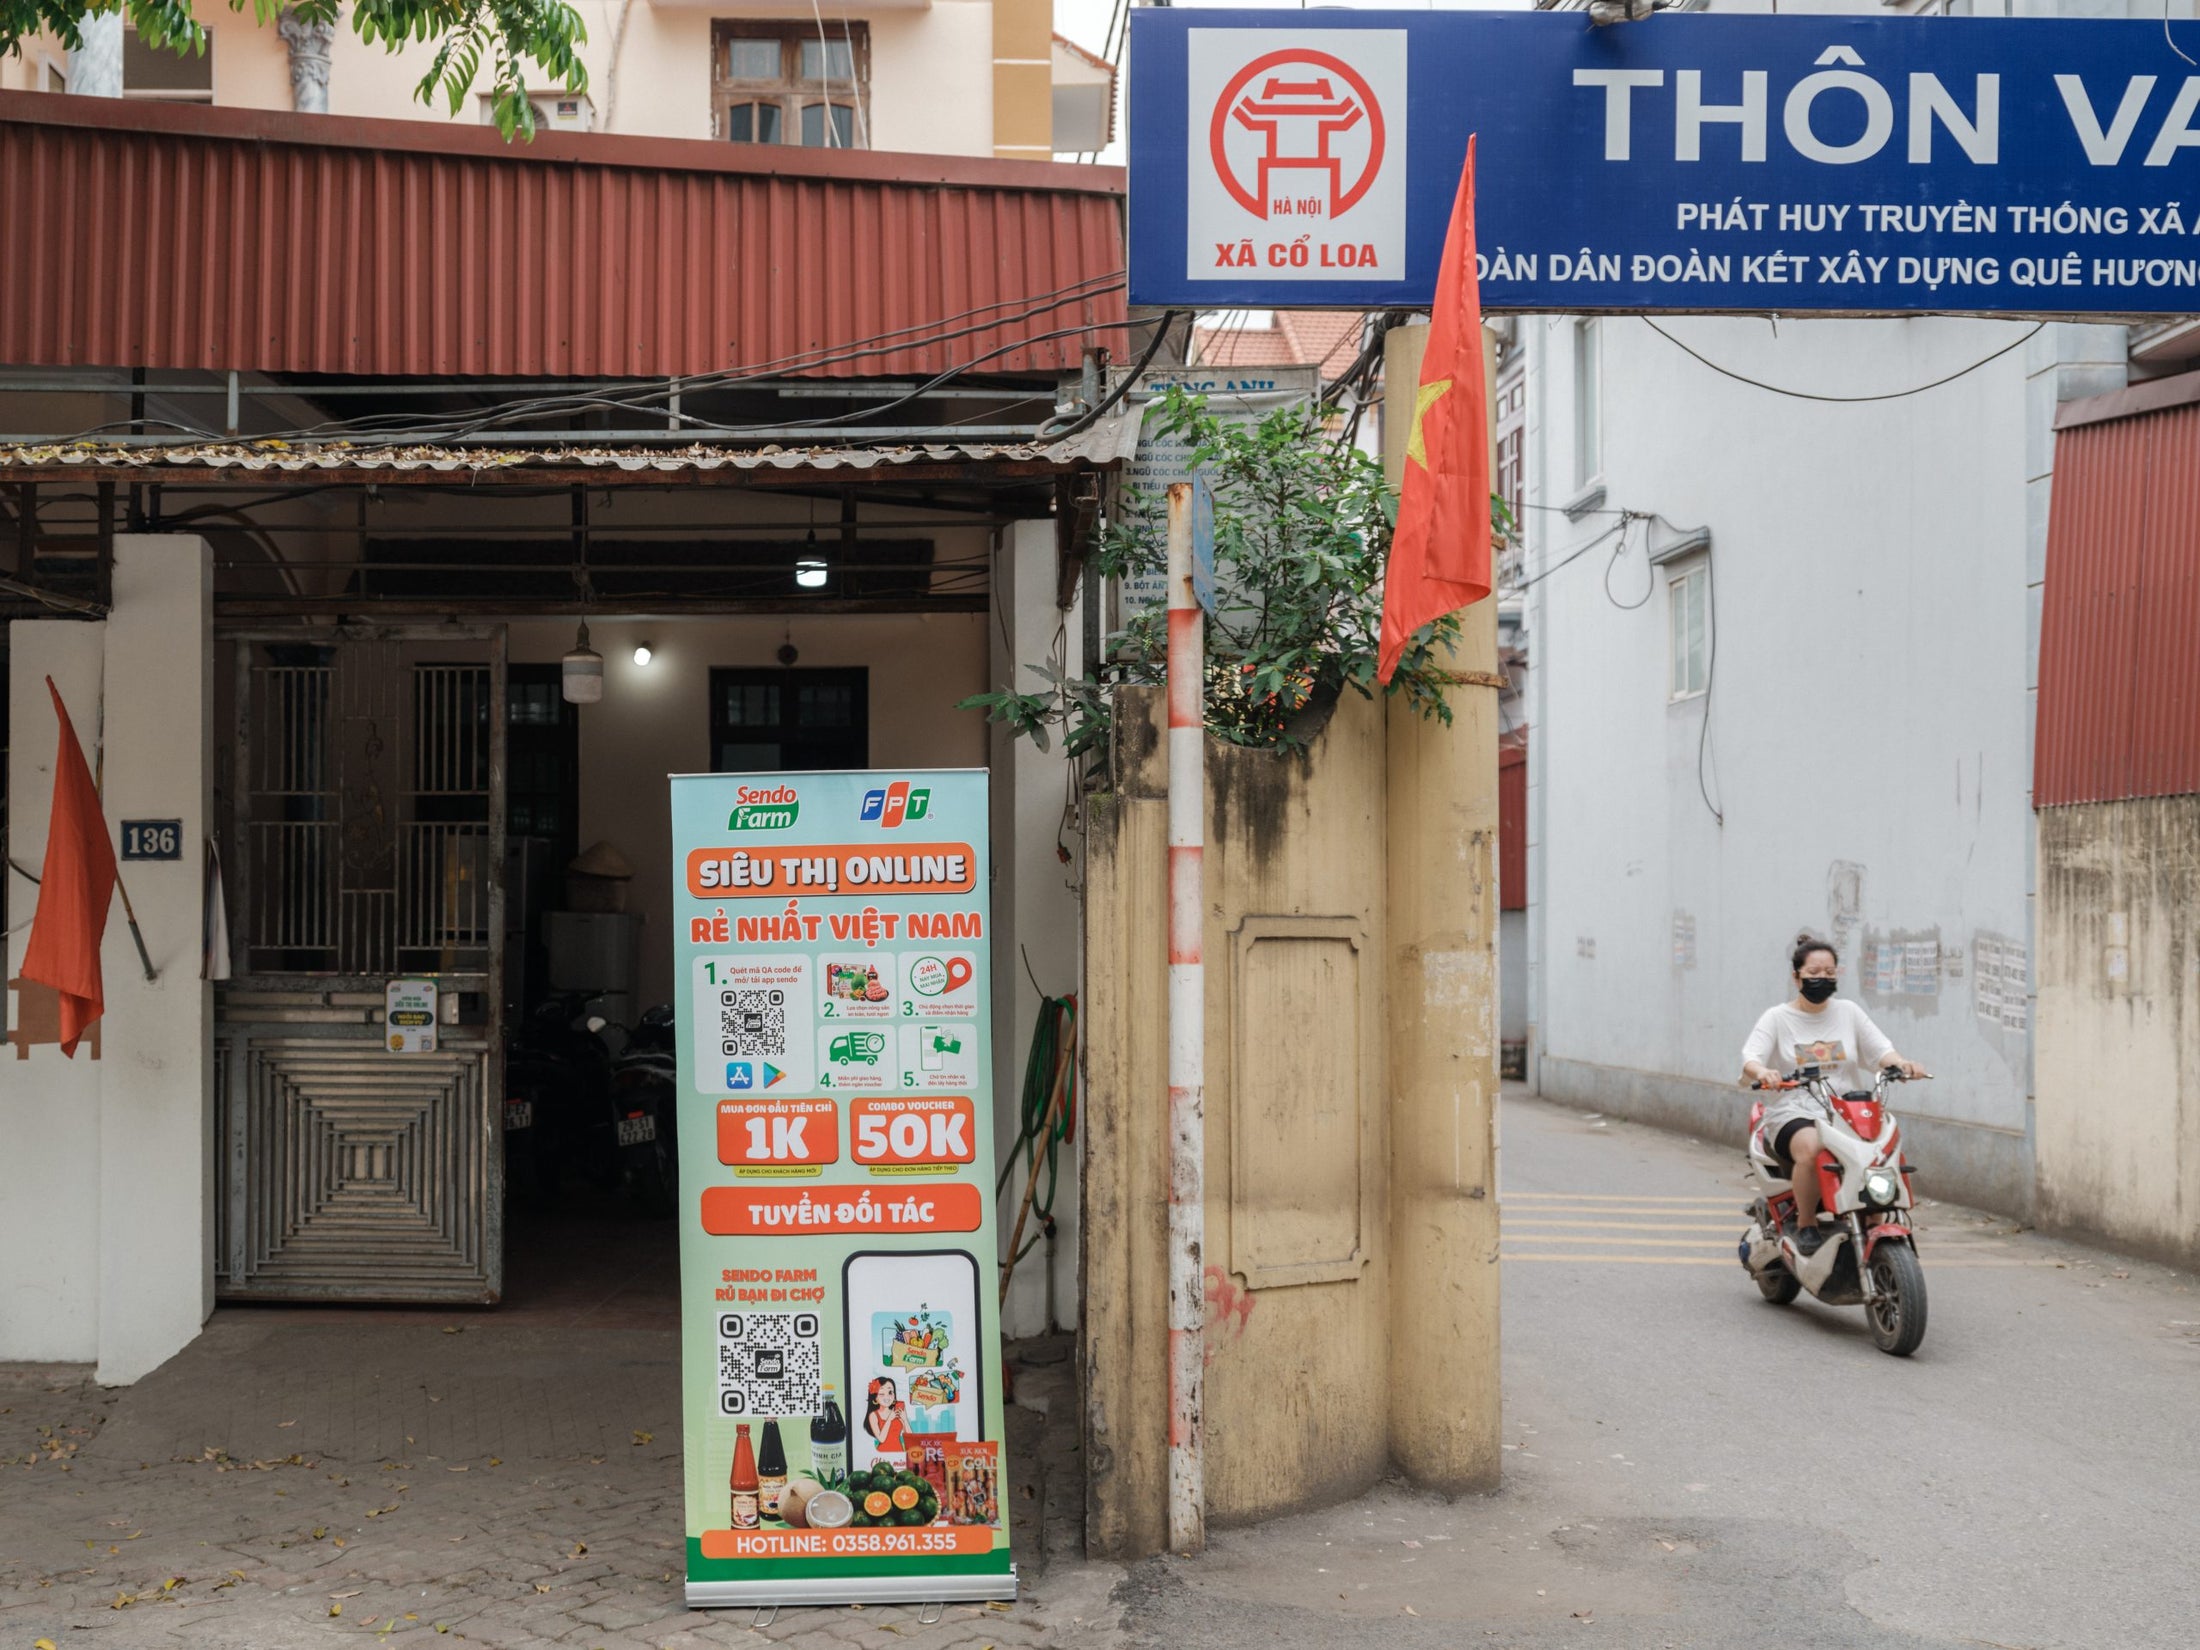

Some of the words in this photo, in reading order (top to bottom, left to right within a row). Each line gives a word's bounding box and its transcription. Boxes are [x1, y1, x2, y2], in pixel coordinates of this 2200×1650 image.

[1573, 45, 2000, 165] THÔN
[1273, 198, 1294, 215] HÀ
[1297, 198, 1322, 218] NỘI
[1677, 197, 1769, 231] PHÁT
[1779, 204, 1850, 232] HUY
[1859, 200, 1997, 234] TRUYỀN
[2007, 201, 2129, 235] THỐNG
[2137, 202, 2186, 235] XÃ
[1215, 239, 1257, 268] XÃ
[1267, 233, 1311, 268] CỔ
[1320, 243, 1378, 268] LOA
[1476, 246, 1537, 281] OÀN
[1549, 247, 1621, 282] DÂN
[1631, 248, 1731, 282] ĐOÀN
[1743, 250, 1809, 283] KẾT
[1818, 251, 1889, 284] XÂY
[1898, 258, 2000, 290] DỰNG
[2010, 252, 2082, 287] QUÊ
[2093, 258, 2200, 287] HƯƠN
[736, 785, 796, 804] Sendo
[736, 808, 791, 828] Farm
[129, 827, 175, 854] 136
[700, 852, 773, 888] SIÊU
[780, 857, 838, 891] THỊ
[846, 854, 966, 884] ONLINE
[690, 908, 729, 943] RẺ
[737, 899, 822, 942] NHẤT
[828, 907, 900, 948] VIỆT
[908, 912, 983, 939] NAM
[704, 961, 728, 985] 1.
[774, 966, 791, 974] code
[920, 963, 937, 975] 24H
[823, 1001, 840, 1017] 2.
[902, 1001, 919, 1016] 3.
[820, 1073, 837, 1088] 4.
[903, 1071, 919, 1087] 5.
[721, 1104, 744, 1114] MUA
[745, 1104, 767, 1113] ĐƠN
[790, 1102, 814, 1113] TIÊN
[868, 1102, 905, 1111] COMBO
[907, 1101, 955, 1110] VOUCHER
[745, 1116, 810, 1159] 1K
[857, 1113, 969, 1158] 50K
[748, 1191, 831, 1226] TUYỂN
[834, 1190, 882, 1223] ĐỐI
[888, 1196, 935, 1223] TÁC
[722, 1269, 773, 1283] SENDO
[775, 1268, 817, 1282] FARM
[715, 1284, 736, 1301] RỦ
[738, 1288, 768, 1305] BẠN
[770, 1288, 787, 1301] ĐI
[790, 1286, 825, 1305] CHỢ
[737, 1536, 827, 1553] HOTLINE:
[832, 1534, 957, 1552] 0358.961.355
